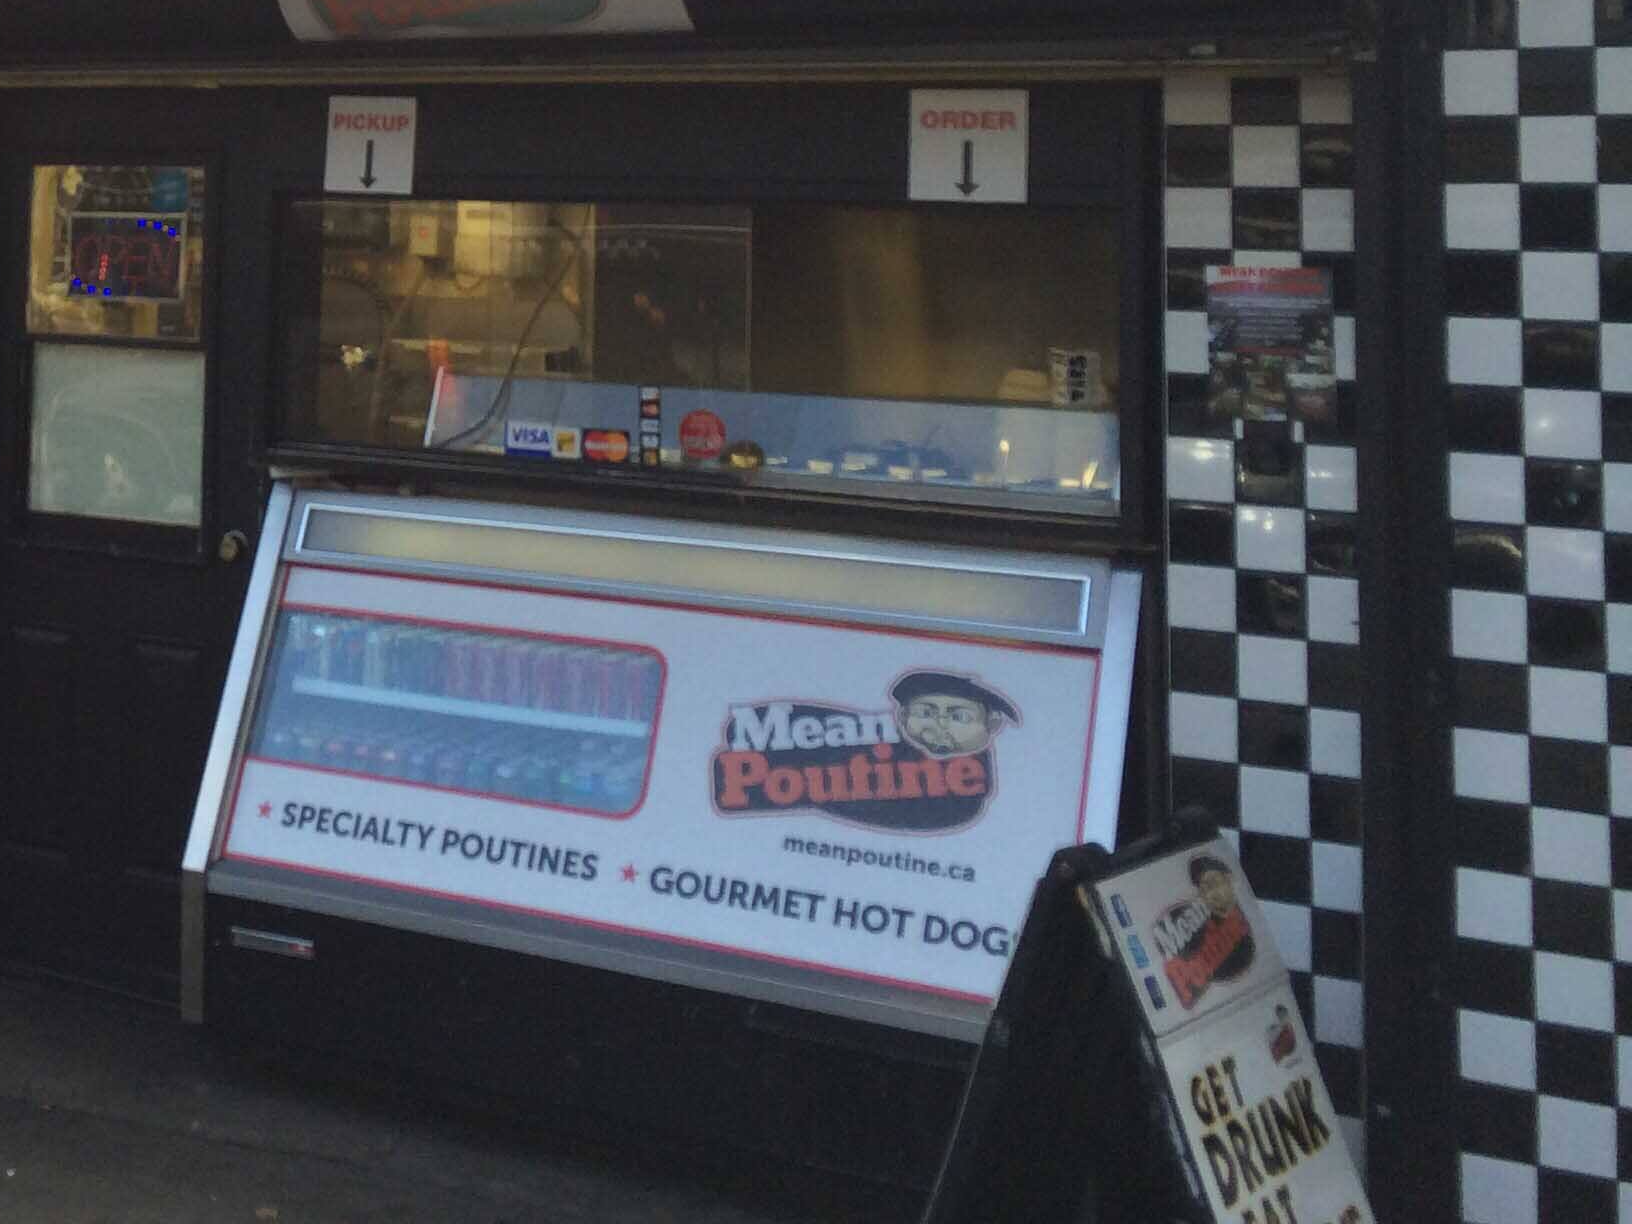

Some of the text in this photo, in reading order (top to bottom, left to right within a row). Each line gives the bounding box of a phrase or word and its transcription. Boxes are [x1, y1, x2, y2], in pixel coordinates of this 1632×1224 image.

[334, 112, 410, 132] PICKUP
[919, 109, 1017, 131] ORDER
[512, 427, 549, 444] VISA
[727, 702, 902, 753] Mean
[714, 743, 987, 811] Poutine
[281, 801, 435, 854] SPECIALTY
[440, 827, 599, 882] POUTINES
[649, 865, 828, 923] GOURMET
[832, 897, 915, 941] HOT
[783, 832, 977, 883] meanpoutine.ca
[1190, 1055, 1244, 1127] GET
[1201, 1076, 1331, 1210] DRUNK
